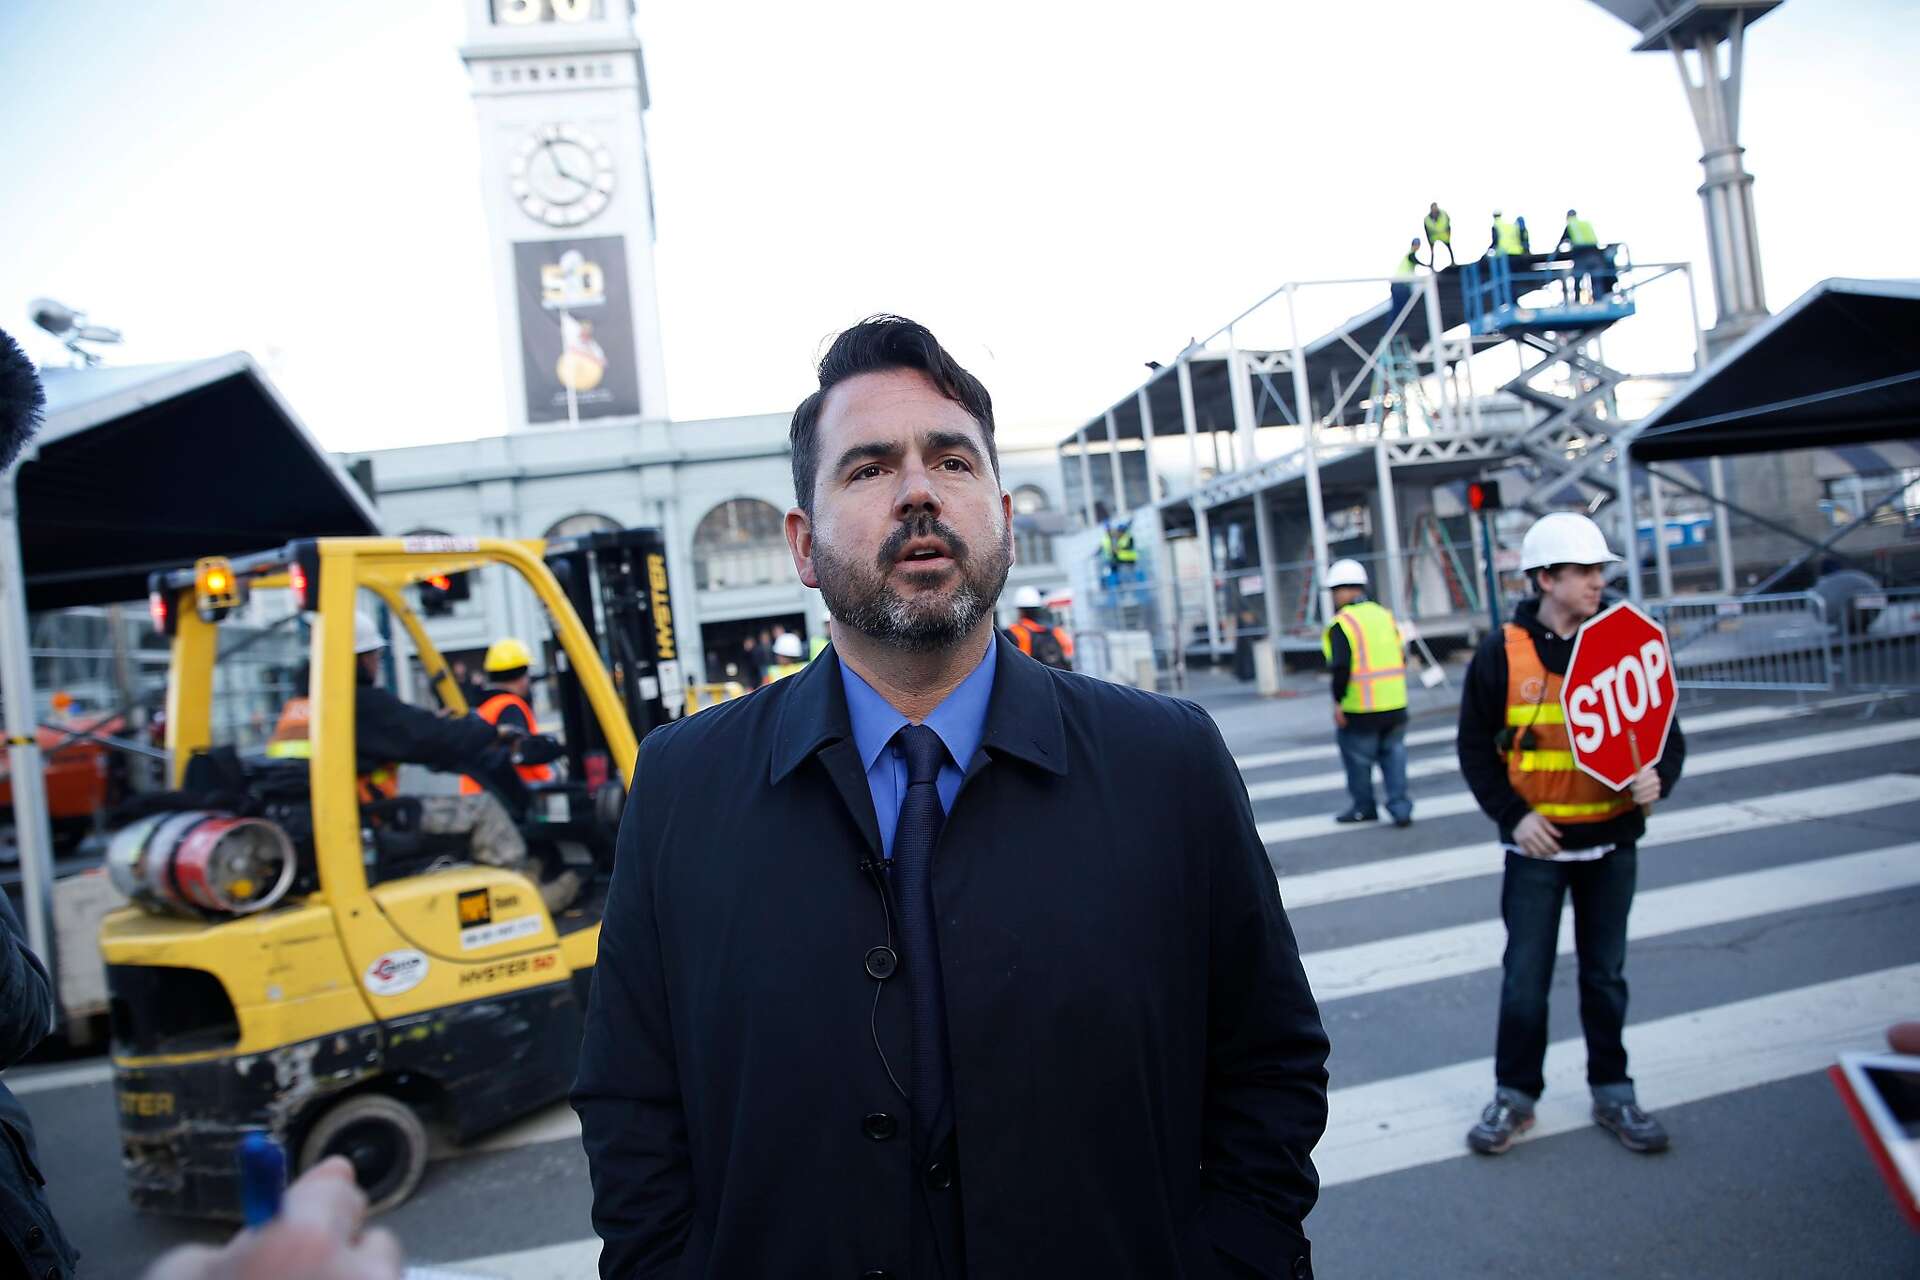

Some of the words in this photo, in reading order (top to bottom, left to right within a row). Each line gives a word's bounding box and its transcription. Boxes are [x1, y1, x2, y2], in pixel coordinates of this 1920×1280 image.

[647, 553, 677, 659] HYSTER
[1569, 639, 1667, 753] STOP
[459, 957, 529, 987] HYSTER
